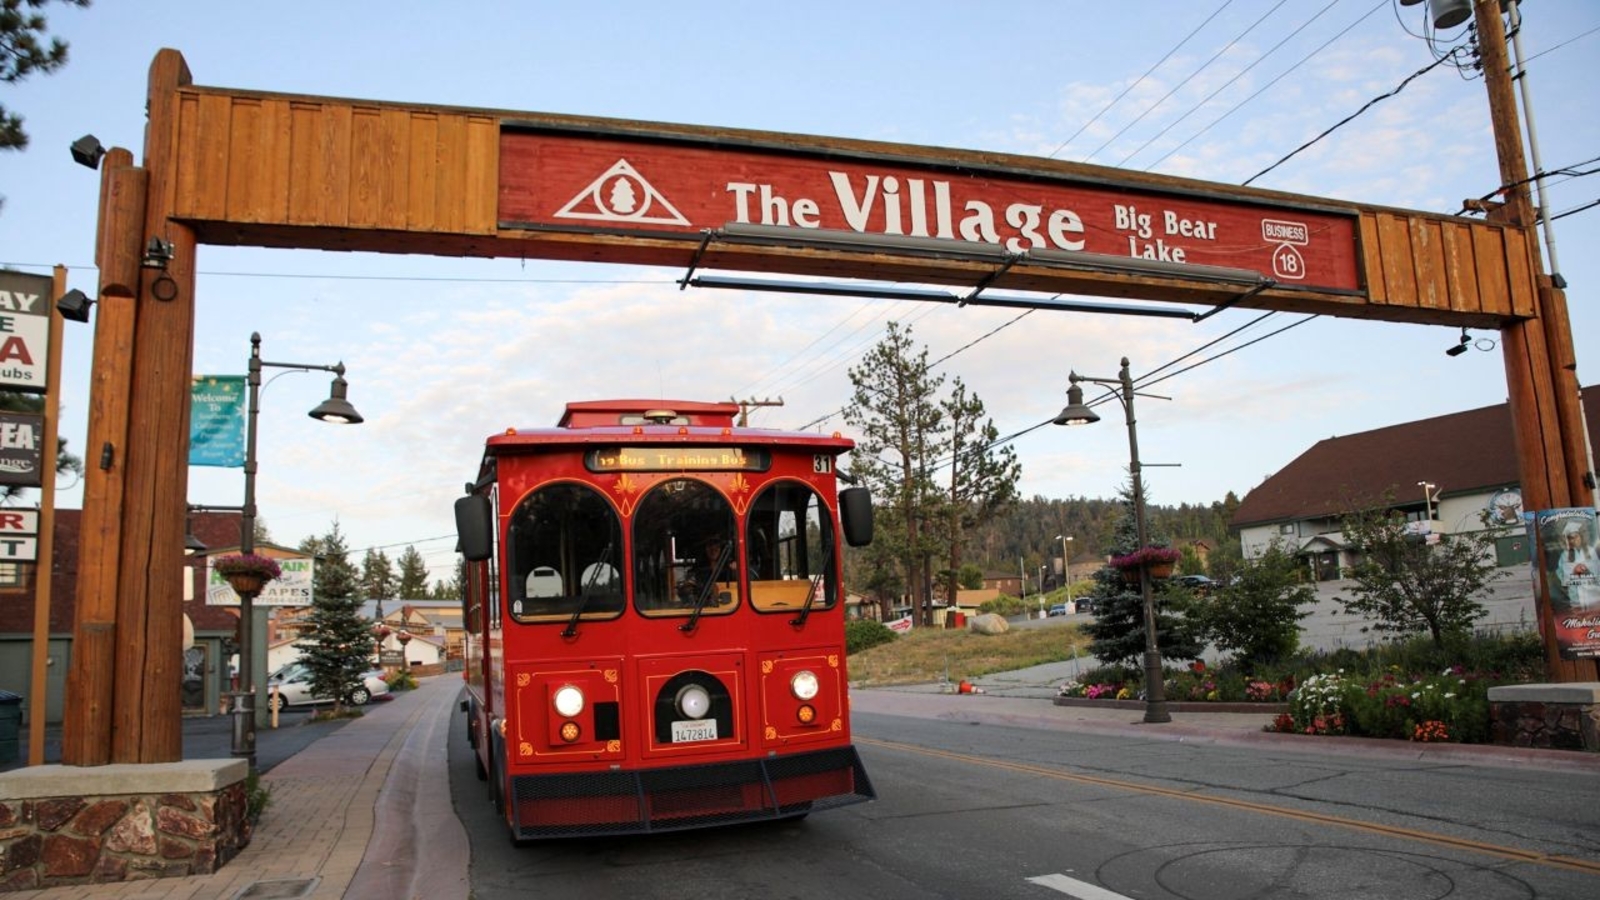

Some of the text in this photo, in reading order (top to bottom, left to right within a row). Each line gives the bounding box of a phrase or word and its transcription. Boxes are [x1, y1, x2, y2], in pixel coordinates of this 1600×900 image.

[726, 171, 1086, 253] The Village
[1114, 204, 1218, 240] Big Bear
[1265, 223, 1305, 241] BUSINESS
[1129, 235, 1186, 265] Lake
[1279, 254, 1298, 273] 18
[190, 392, 237, 403] Welcome
[207, 402, 221, 412] To
[0, 421, 34, 450] EA
[619, 454, 645, 466] Bus
[657, 453, 718, 466] Training
[721, 453, 747, 466] Bus
[814, 455, 831, 472] 31
[281, 561, 310, 572] AIN
[264, 587, 310, 598] APES
[675, 728, 714, 742] 1472814
